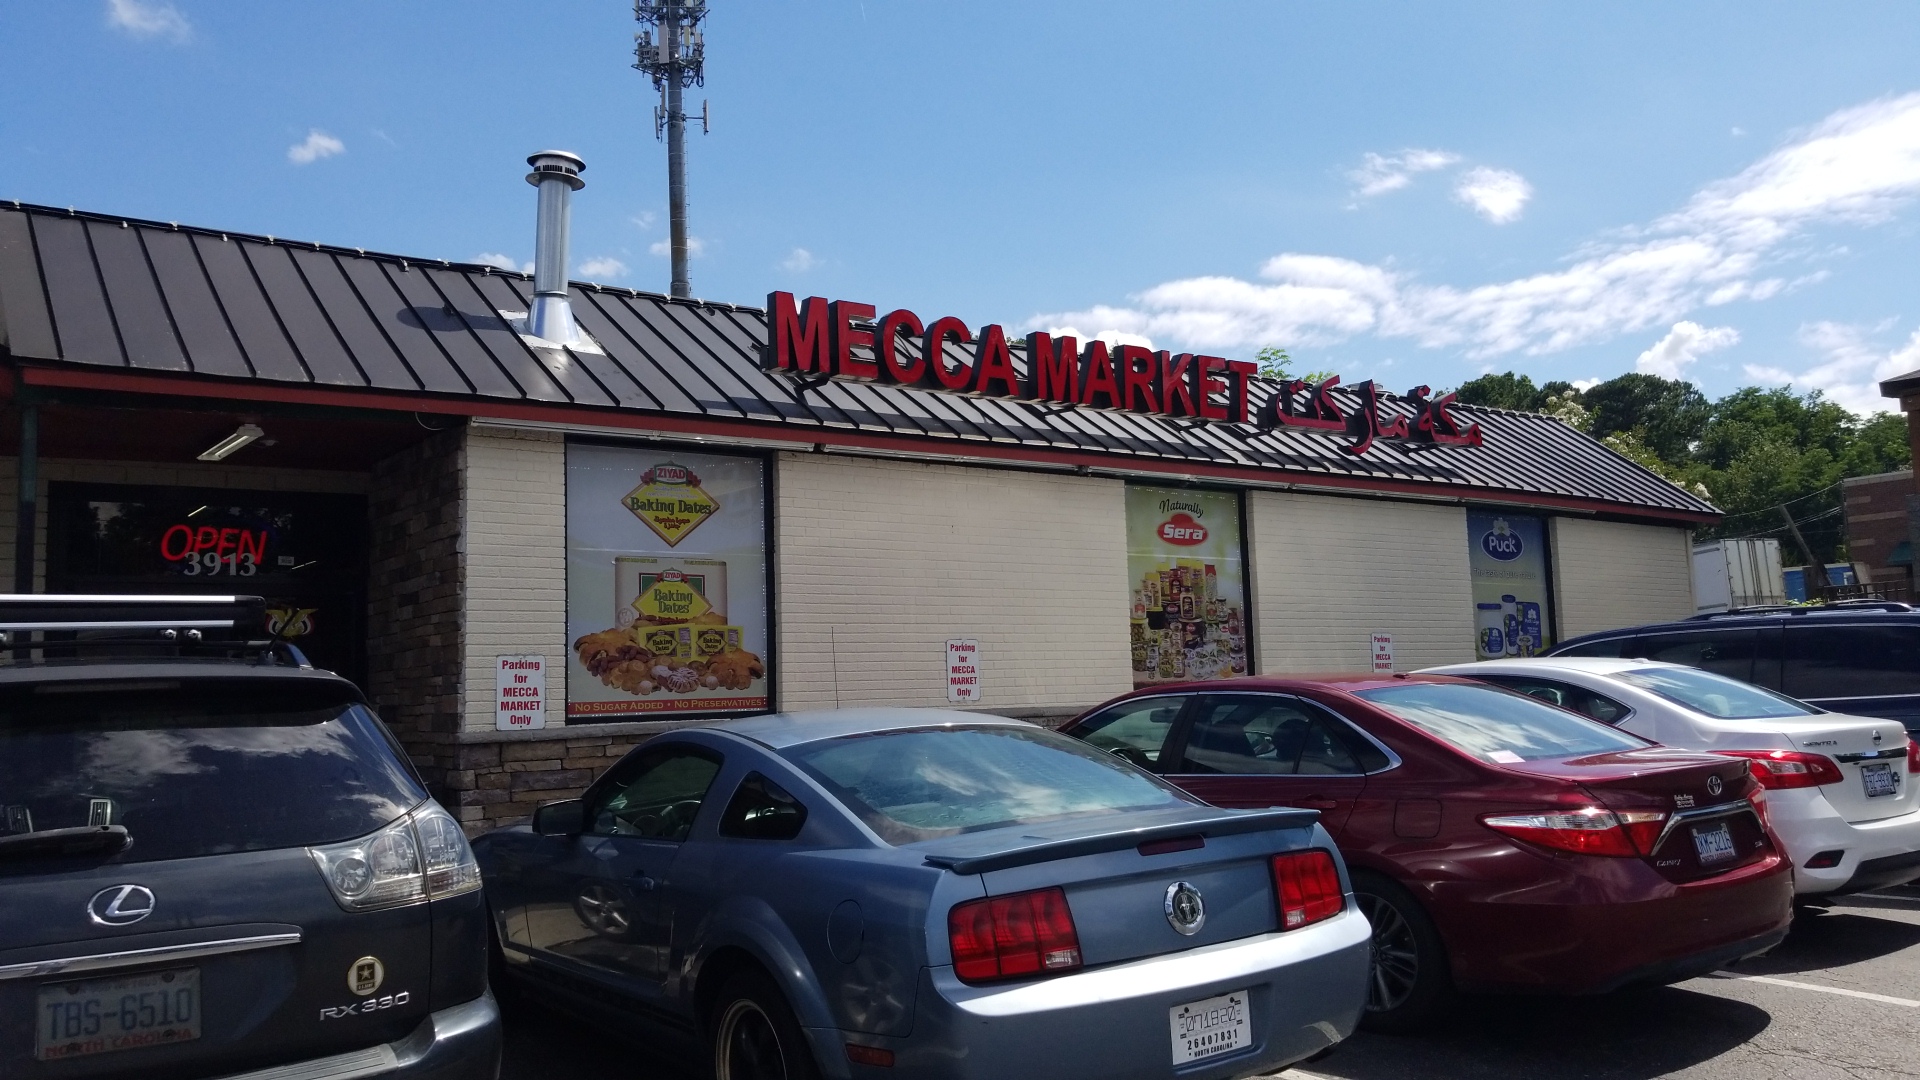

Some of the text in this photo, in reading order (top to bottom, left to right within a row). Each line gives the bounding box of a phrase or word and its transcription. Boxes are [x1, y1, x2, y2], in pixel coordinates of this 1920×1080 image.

[767, 290, 1258, 423] MECCA MARKET
[657, 467, 686, 480] ZIYAD
[630, 497, 711, 515] Baking Dates
[1159, 499, 1204, 518] Naturally
[1163, 524, 1204, 540] Sera
[161, 524, 267, 564] OPEN
[1488, 536, 1517, 553] Puck
[183, 551, 257, 576] 3913
[653, 588, 693, 605] Baking
[658, 601, 690, 614] Dates
[652, 638, 673, 646] Baking
[950, 643, 976, 653] Parking
[501, 660, 541, 671] Parking
[958, 654, 968, 663] for
[951, 665, 976, 674] MECCA
[513, 673, 528, 684] for
[950, 676, 978, 686] MARKET
[502, 686, 539, 698] MECCA
[956, 687, 972, 697] Only
[500, 700, 541, 712] MARKET
[510, 714, 532, 726] Only
[320, 990, 410, 1021] RX 330
[47, 988, 192, 1041] TBS-6510
[1185, 1006, 1236, 1032] 071820
[111, 1027, 192, 1048] CAROLNA
[1187, 1028, 1238, 1051] 26407831
[1194, 1042, 1233, 1058] NORTH CAROLINA
